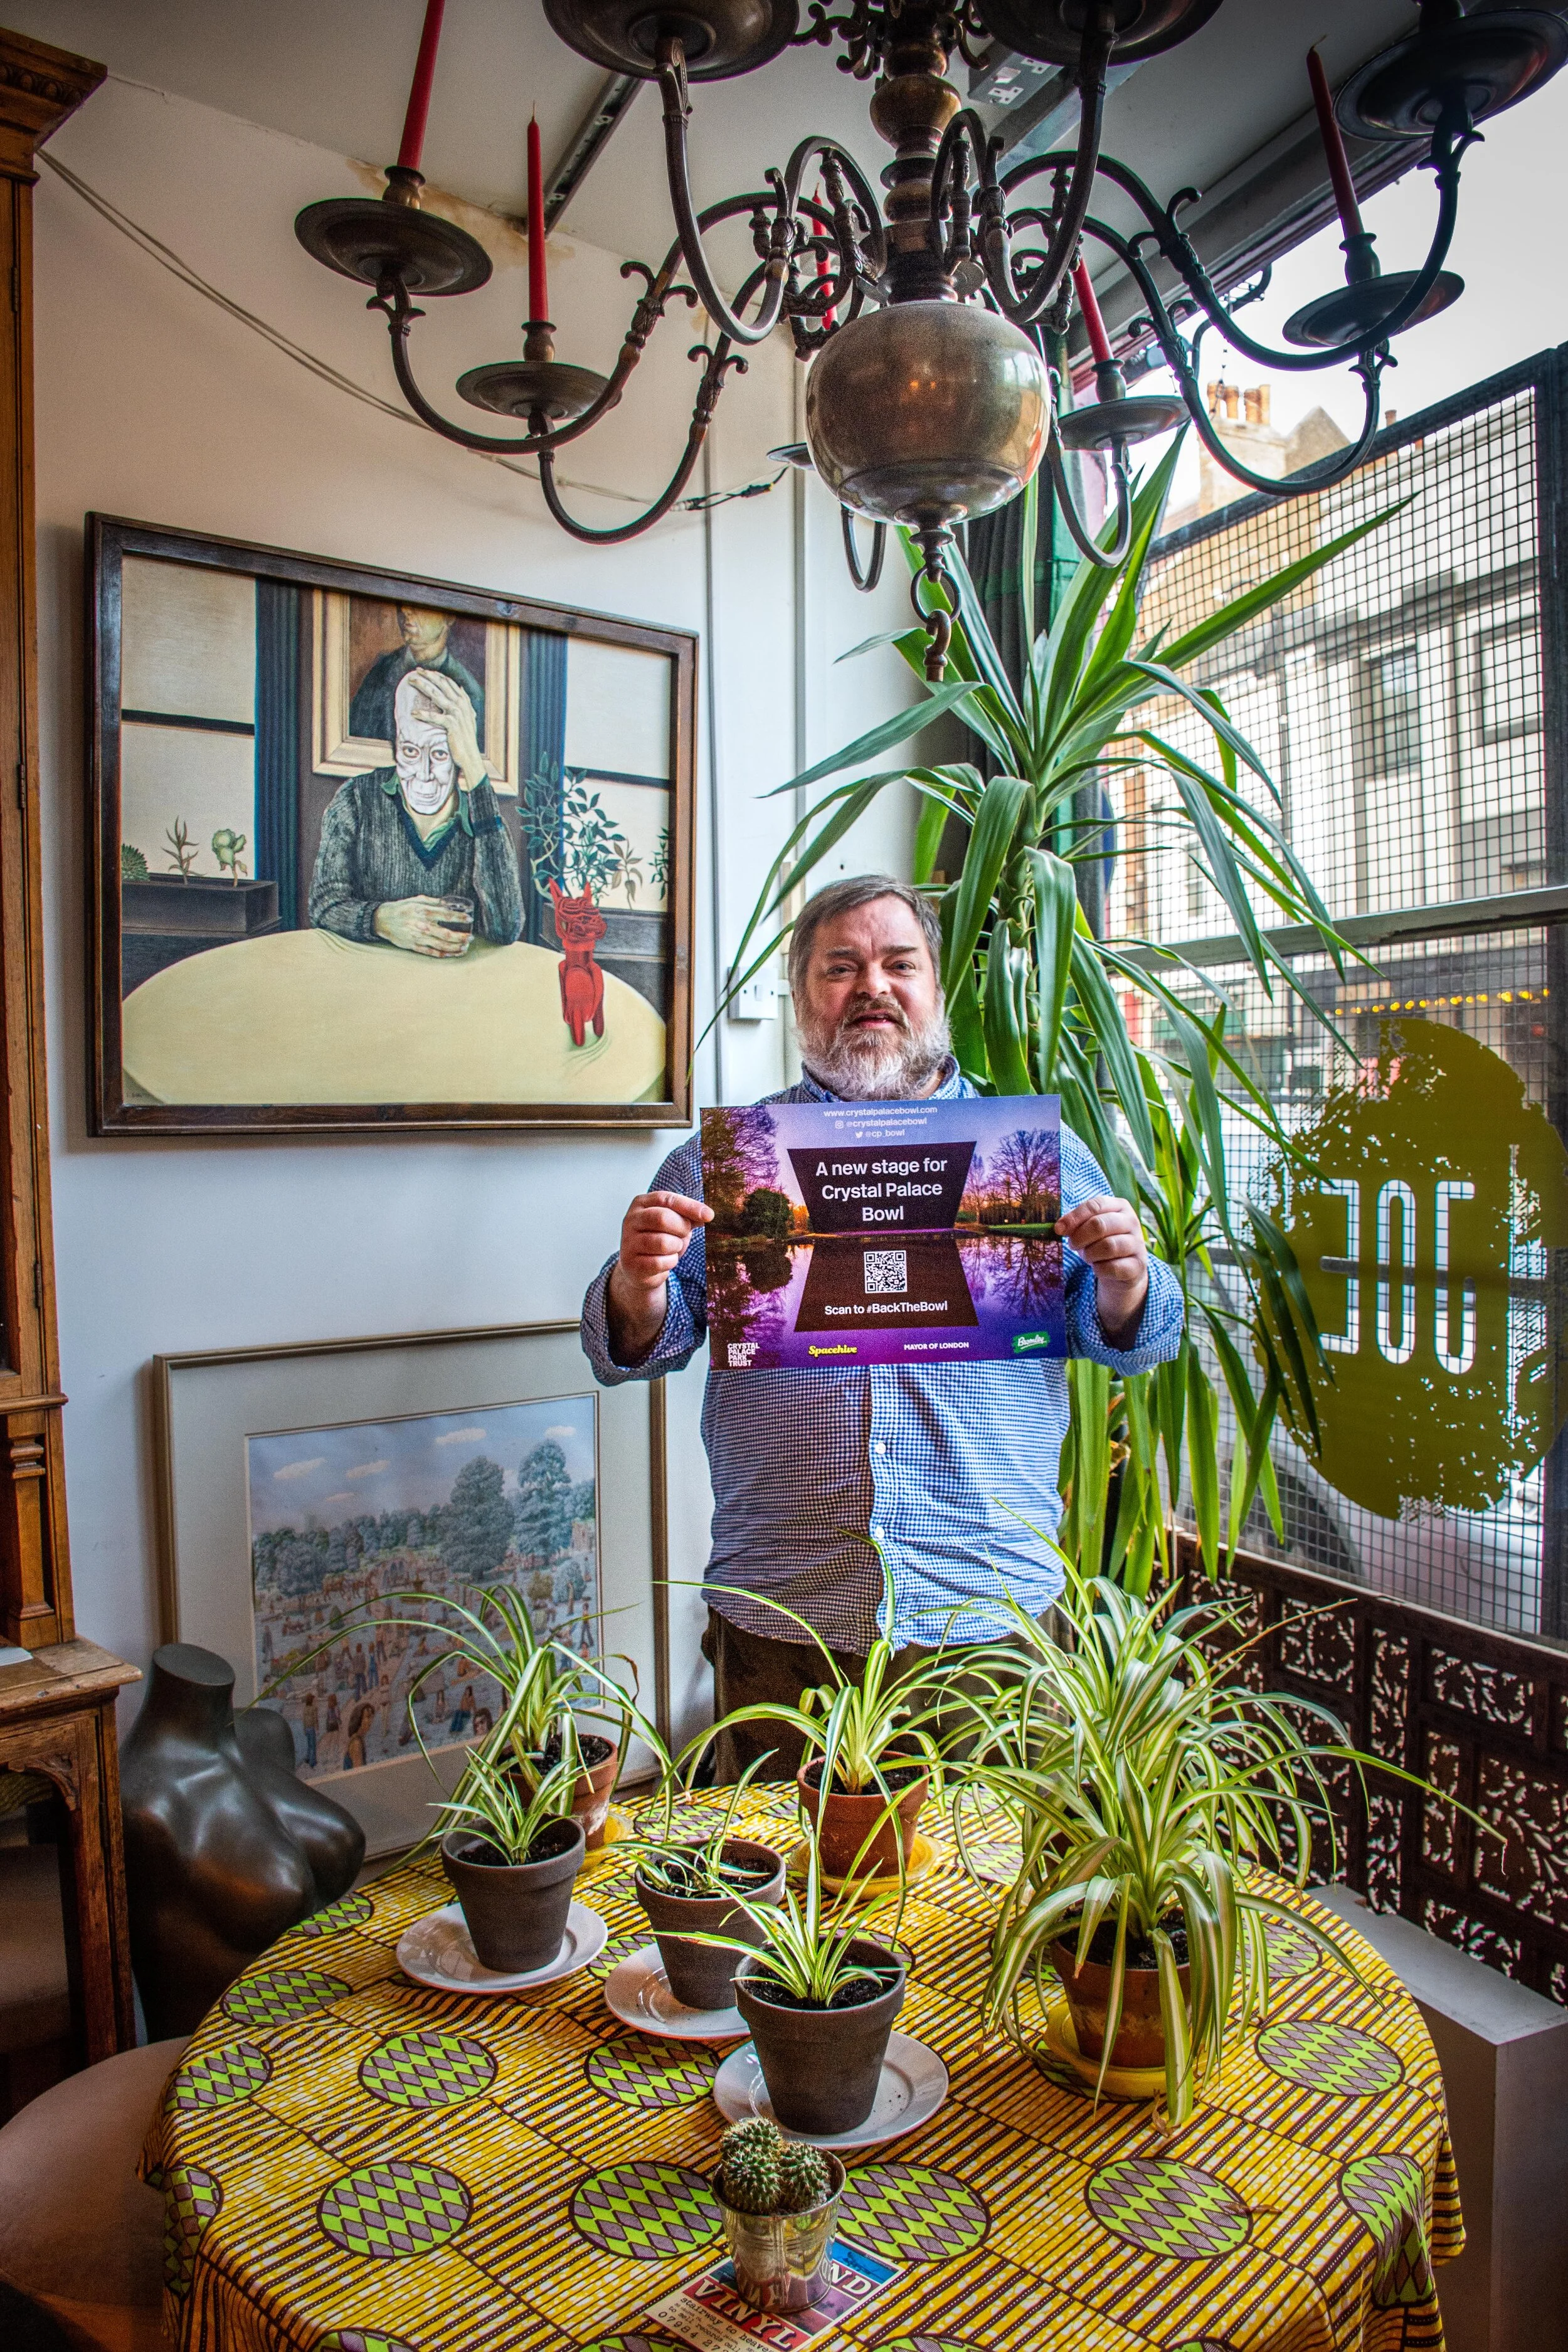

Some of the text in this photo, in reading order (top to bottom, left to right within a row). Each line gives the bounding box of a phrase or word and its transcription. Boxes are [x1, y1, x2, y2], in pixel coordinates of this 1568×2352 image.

[824, 1106, 938, 1118] www.crystalpalacebowl.com
[847, 1118, 927, 1128] @crystalpalacebowl
[815, 1158, 948, 1176] A new stage for
[822, 1182, 942, 1201] Crystal Palace
[862, 1205, 904, 1221] Bowl
[825, 1301, 948, 1315] Scan to #BackTheBowl
[808, 1344, 857, 1357] Spacehive
[830, 2263, 871, 2295] ND
[681, 2297, 723, 2325] stairway
[726, 2324, 737, 2334] to
[694, 2278, 795, 2350] VINYL
[658, 2311, 698, 2339] 07984
[678, 2312, 694, 2324] sell
[696, 2323, 723, 2342] records
[724, 2342, 741, 2352] call
